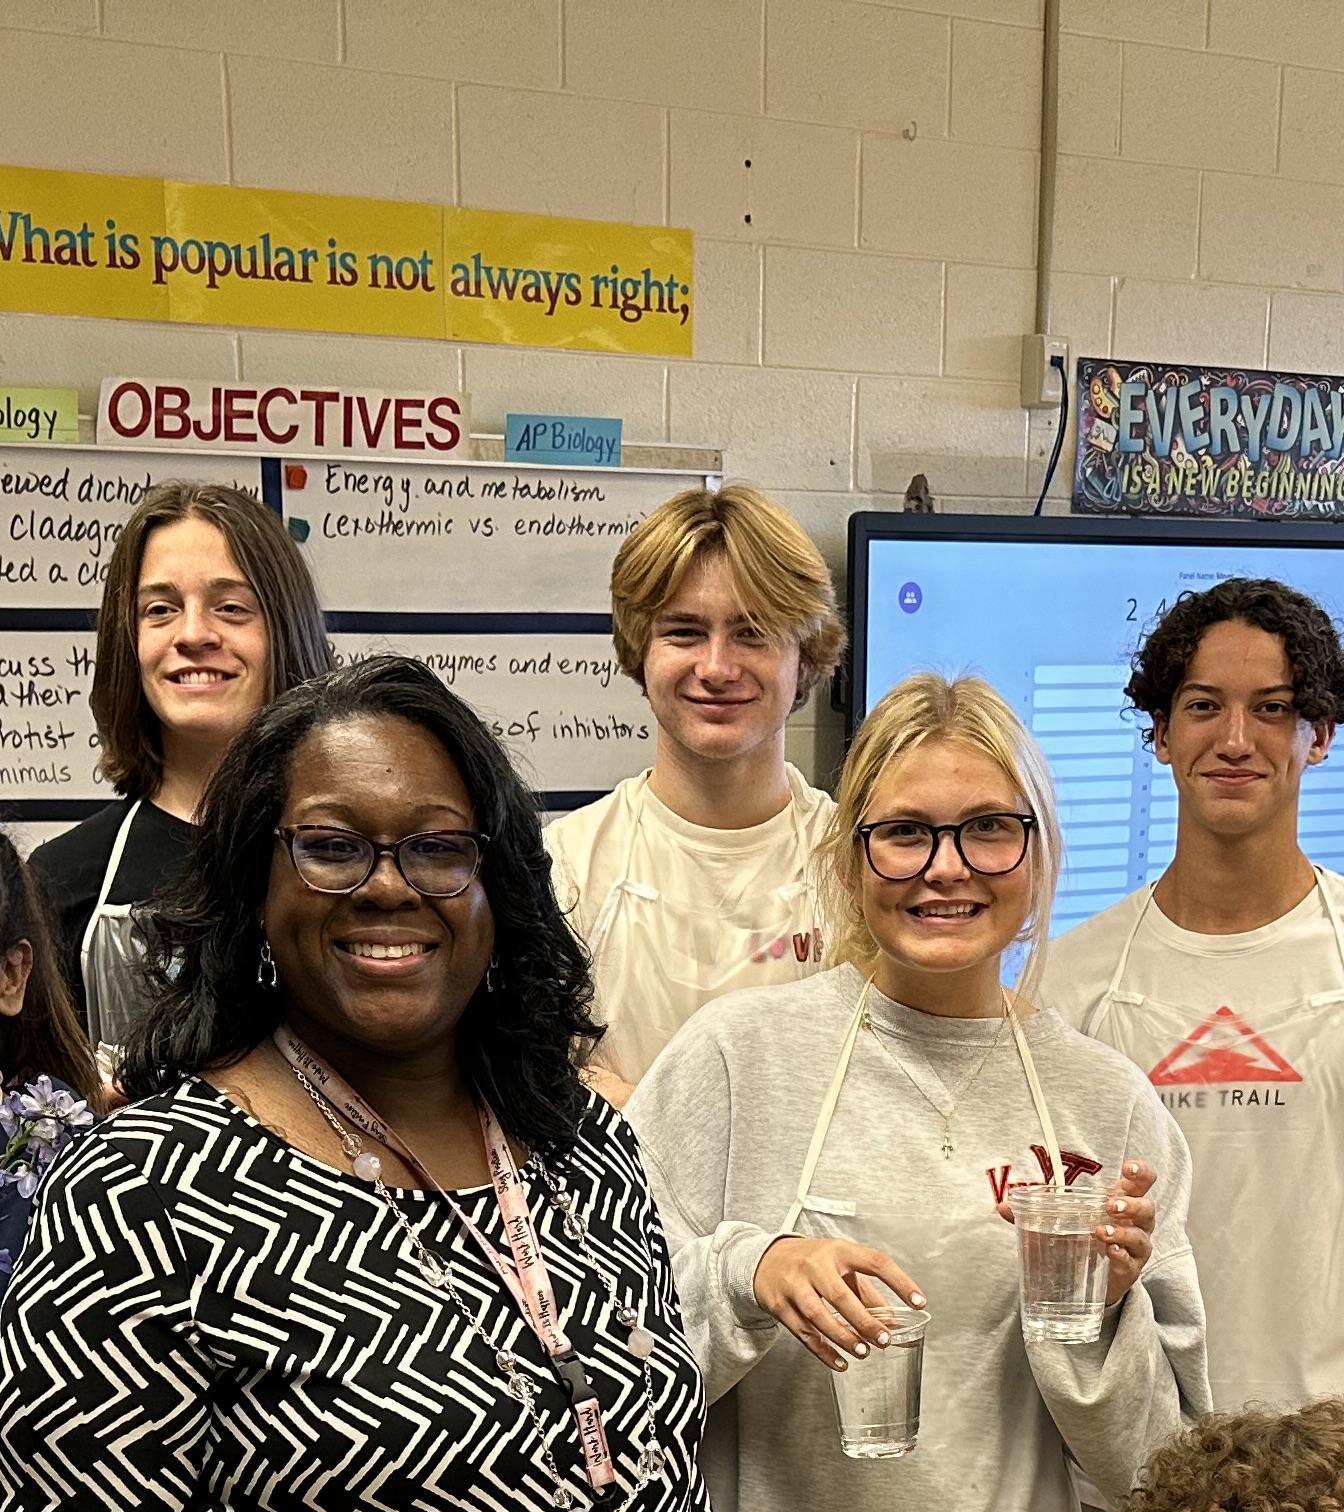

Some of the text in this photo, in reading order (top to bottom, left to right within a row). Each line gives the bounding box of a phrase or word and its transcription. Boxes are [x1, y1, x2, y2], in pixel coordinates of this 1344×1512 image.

[105, 219, 141, 270] is
[150, 232, 318, 289] popular
[326, 238, 358, 287] is
[367, 249, 435, 292] not
[451, 252, 581, 316] always
[590, 264, 689, 325] right;
[108, 381, 462, 450] OBJECTIVES
[515, 421, 617, 462] AP Biology
[424, 473, 474, 500] and
[481, 475, 605, 503] metabolism
[1122, 464, 1145, 496] IS
[1146, 468, 1162, 498] A
[1167, 469, 1222, 498] NEW
[323, 510, 454, 538] (exothermic
[49, 563, 68, 582] a
[1126, 598, 1138, 621] 2
[509, 652, 552, 675] and
[10, 680, 81, 708] their
[552, 711, 650, 740] inhibitors
[1220, 1089, 1287, 1107] TRAIL
